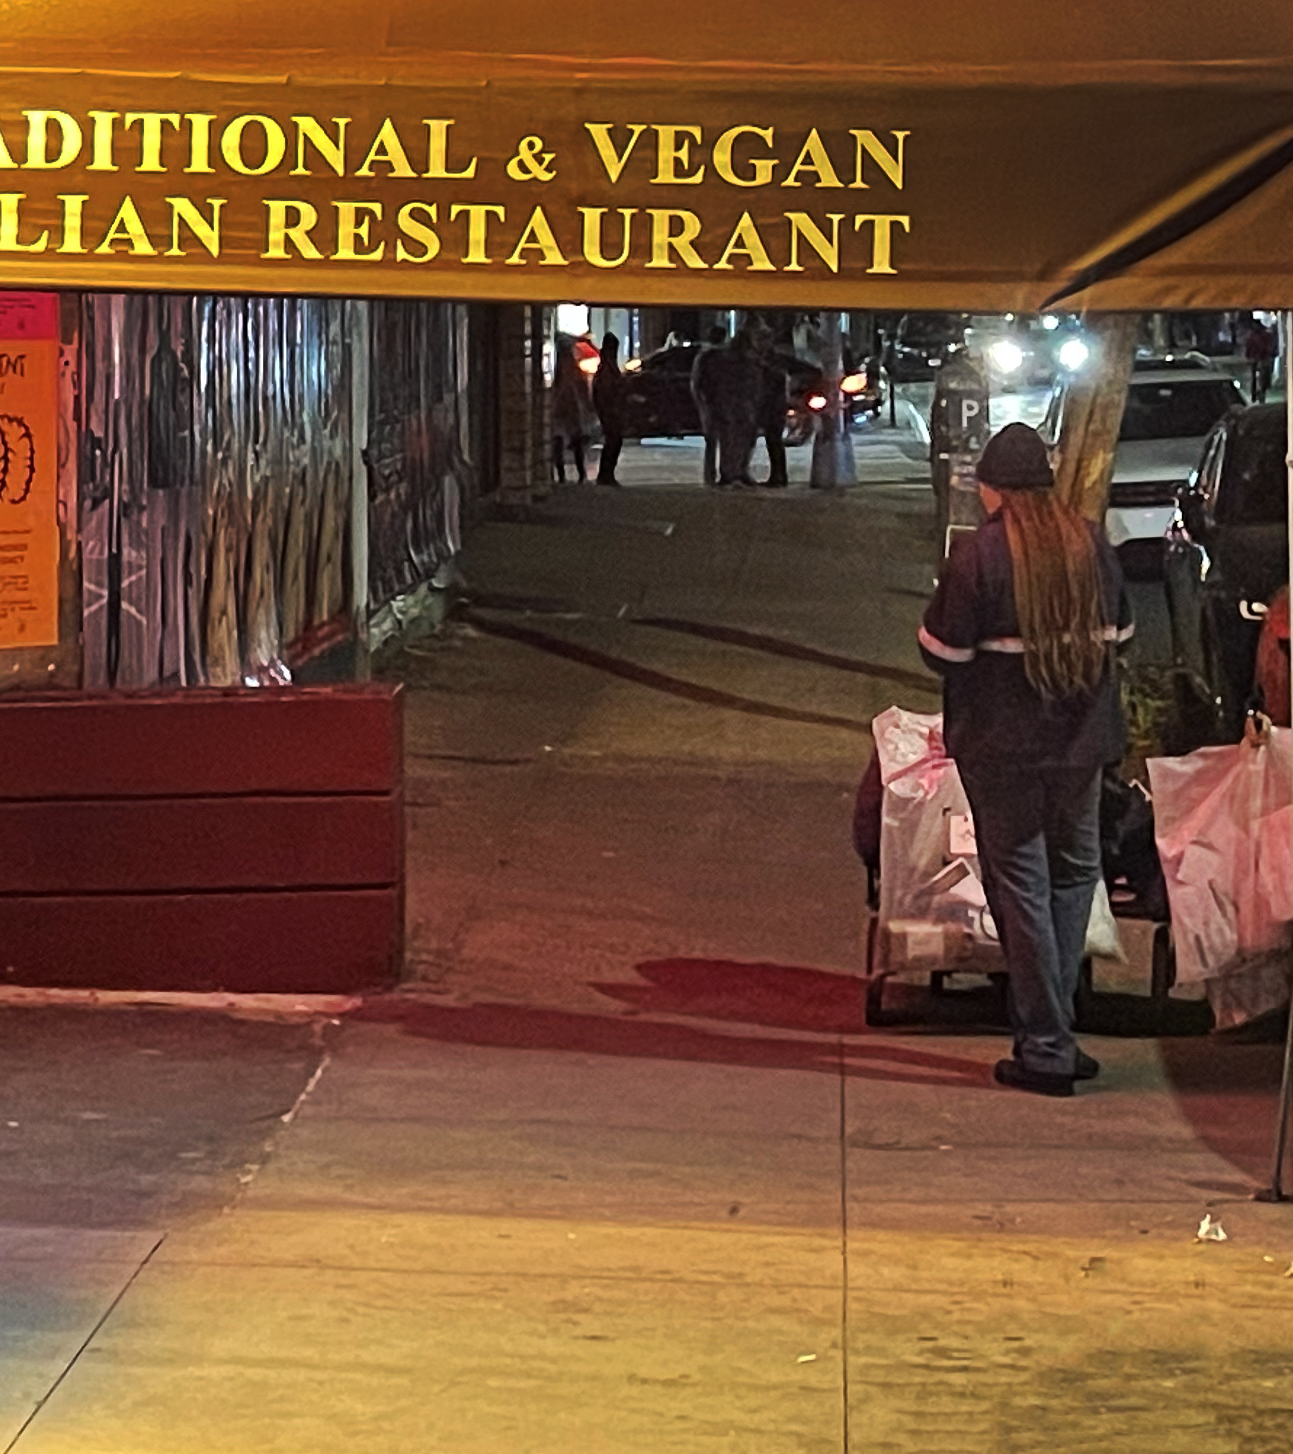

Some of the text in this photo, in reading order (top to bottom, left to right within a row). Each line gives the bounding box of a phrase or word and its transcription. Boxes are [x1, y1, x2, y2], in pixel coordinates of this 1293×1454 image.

[505, 135, 558, 182] &
[584, 122, 909, 191] VEGAN
[259, 197, 912, 275] RESTAURANT
[961, 399, 980, 428] P
